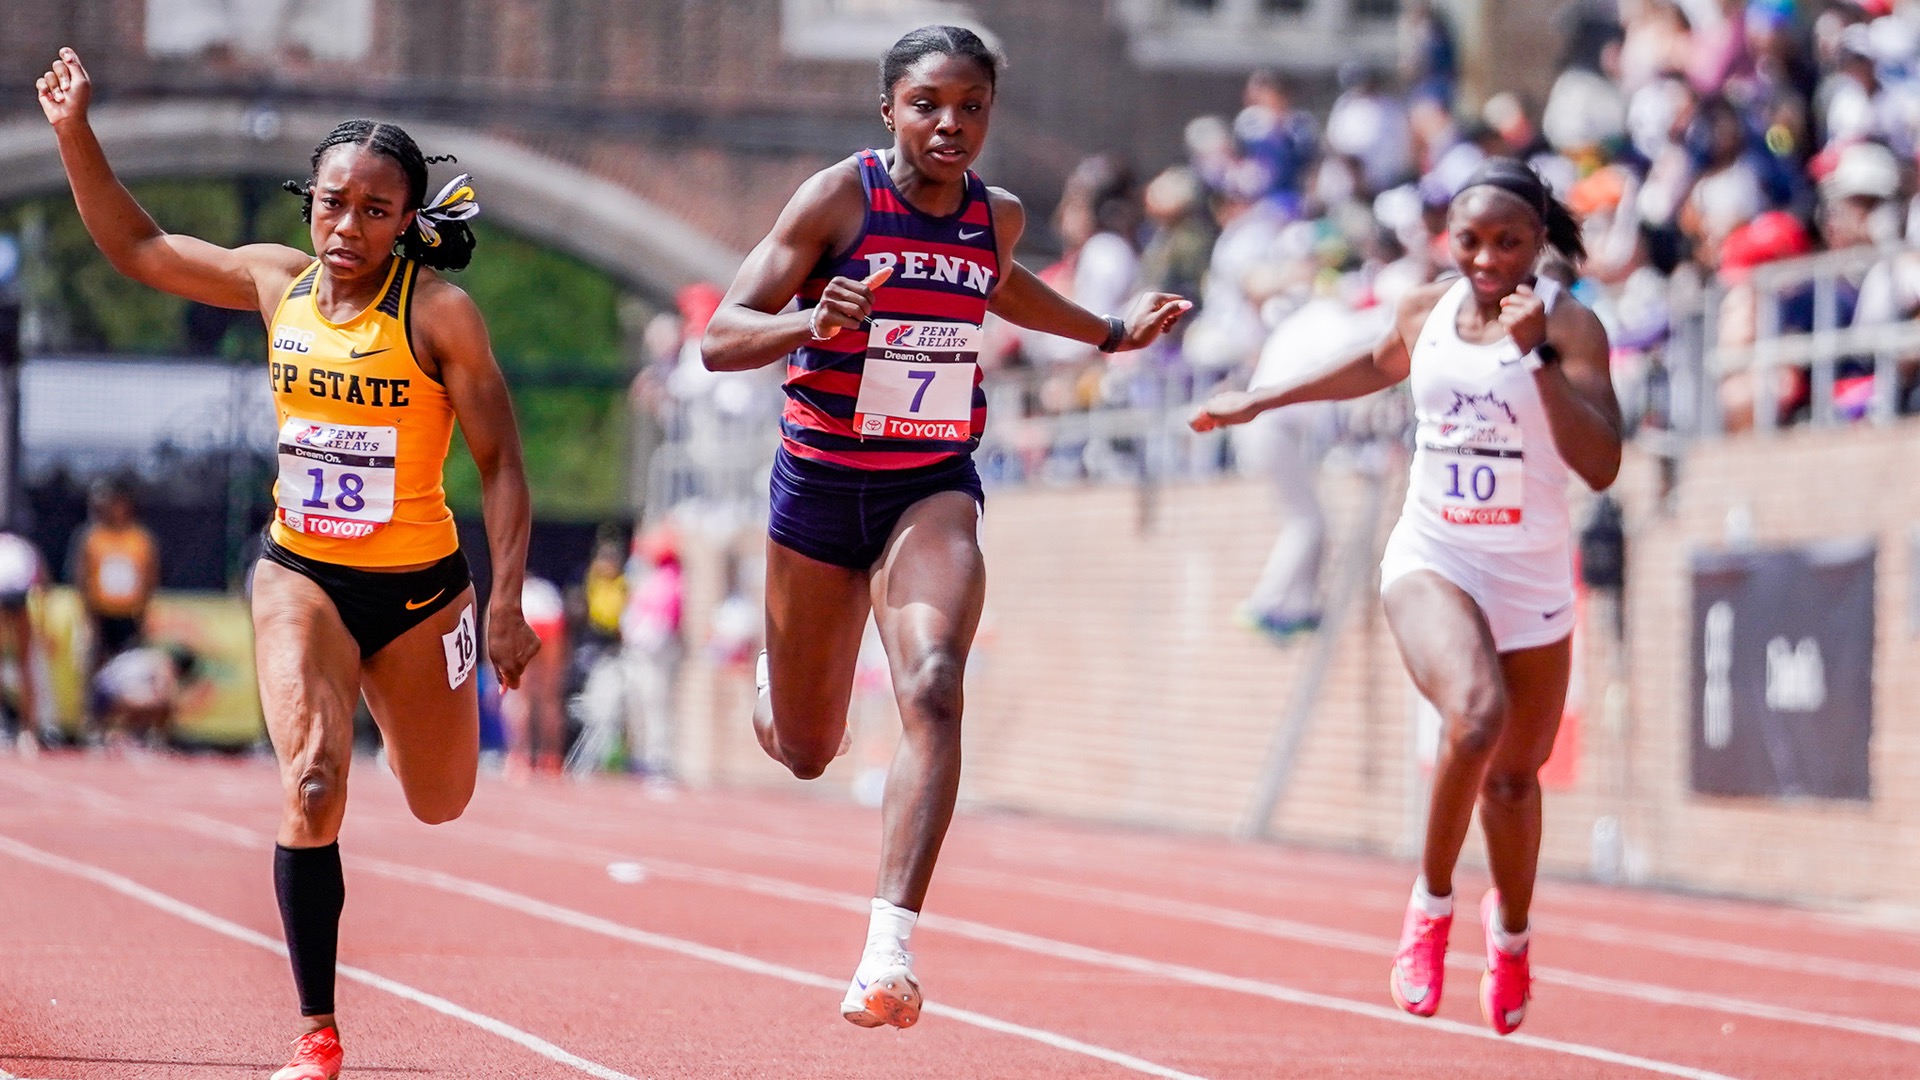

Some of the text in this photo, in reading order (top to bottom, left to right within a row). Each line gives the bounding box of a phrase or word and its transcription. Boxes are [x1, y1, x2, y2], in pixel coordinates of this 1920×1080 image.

[864, 251, 993, 294] PENN
[920, 326, 959, 337] PENN
[916, 337, 967, 347] RELAYS
[884, 350, 931, 362] Dream On.
[309, 368, 410, 407] STATE
[908, 370, 936, 413] 7
[328, 428, 367, 440] PENN
[890, 420, 958, 438] TOYOTA
[1464, 424, 1497, 434] PNN
[324, 440, 380, 452] RELAYS
[295, 448, 341, 463] Dream On.
[302, 468, 365, 512] 18
[1444, 464, 1496, 501] 10
[1443, 507, 1509, 523] TOYOTA
[307, 517, 374, 536] TOYOTA
[455, 617, 473, 674] 18
